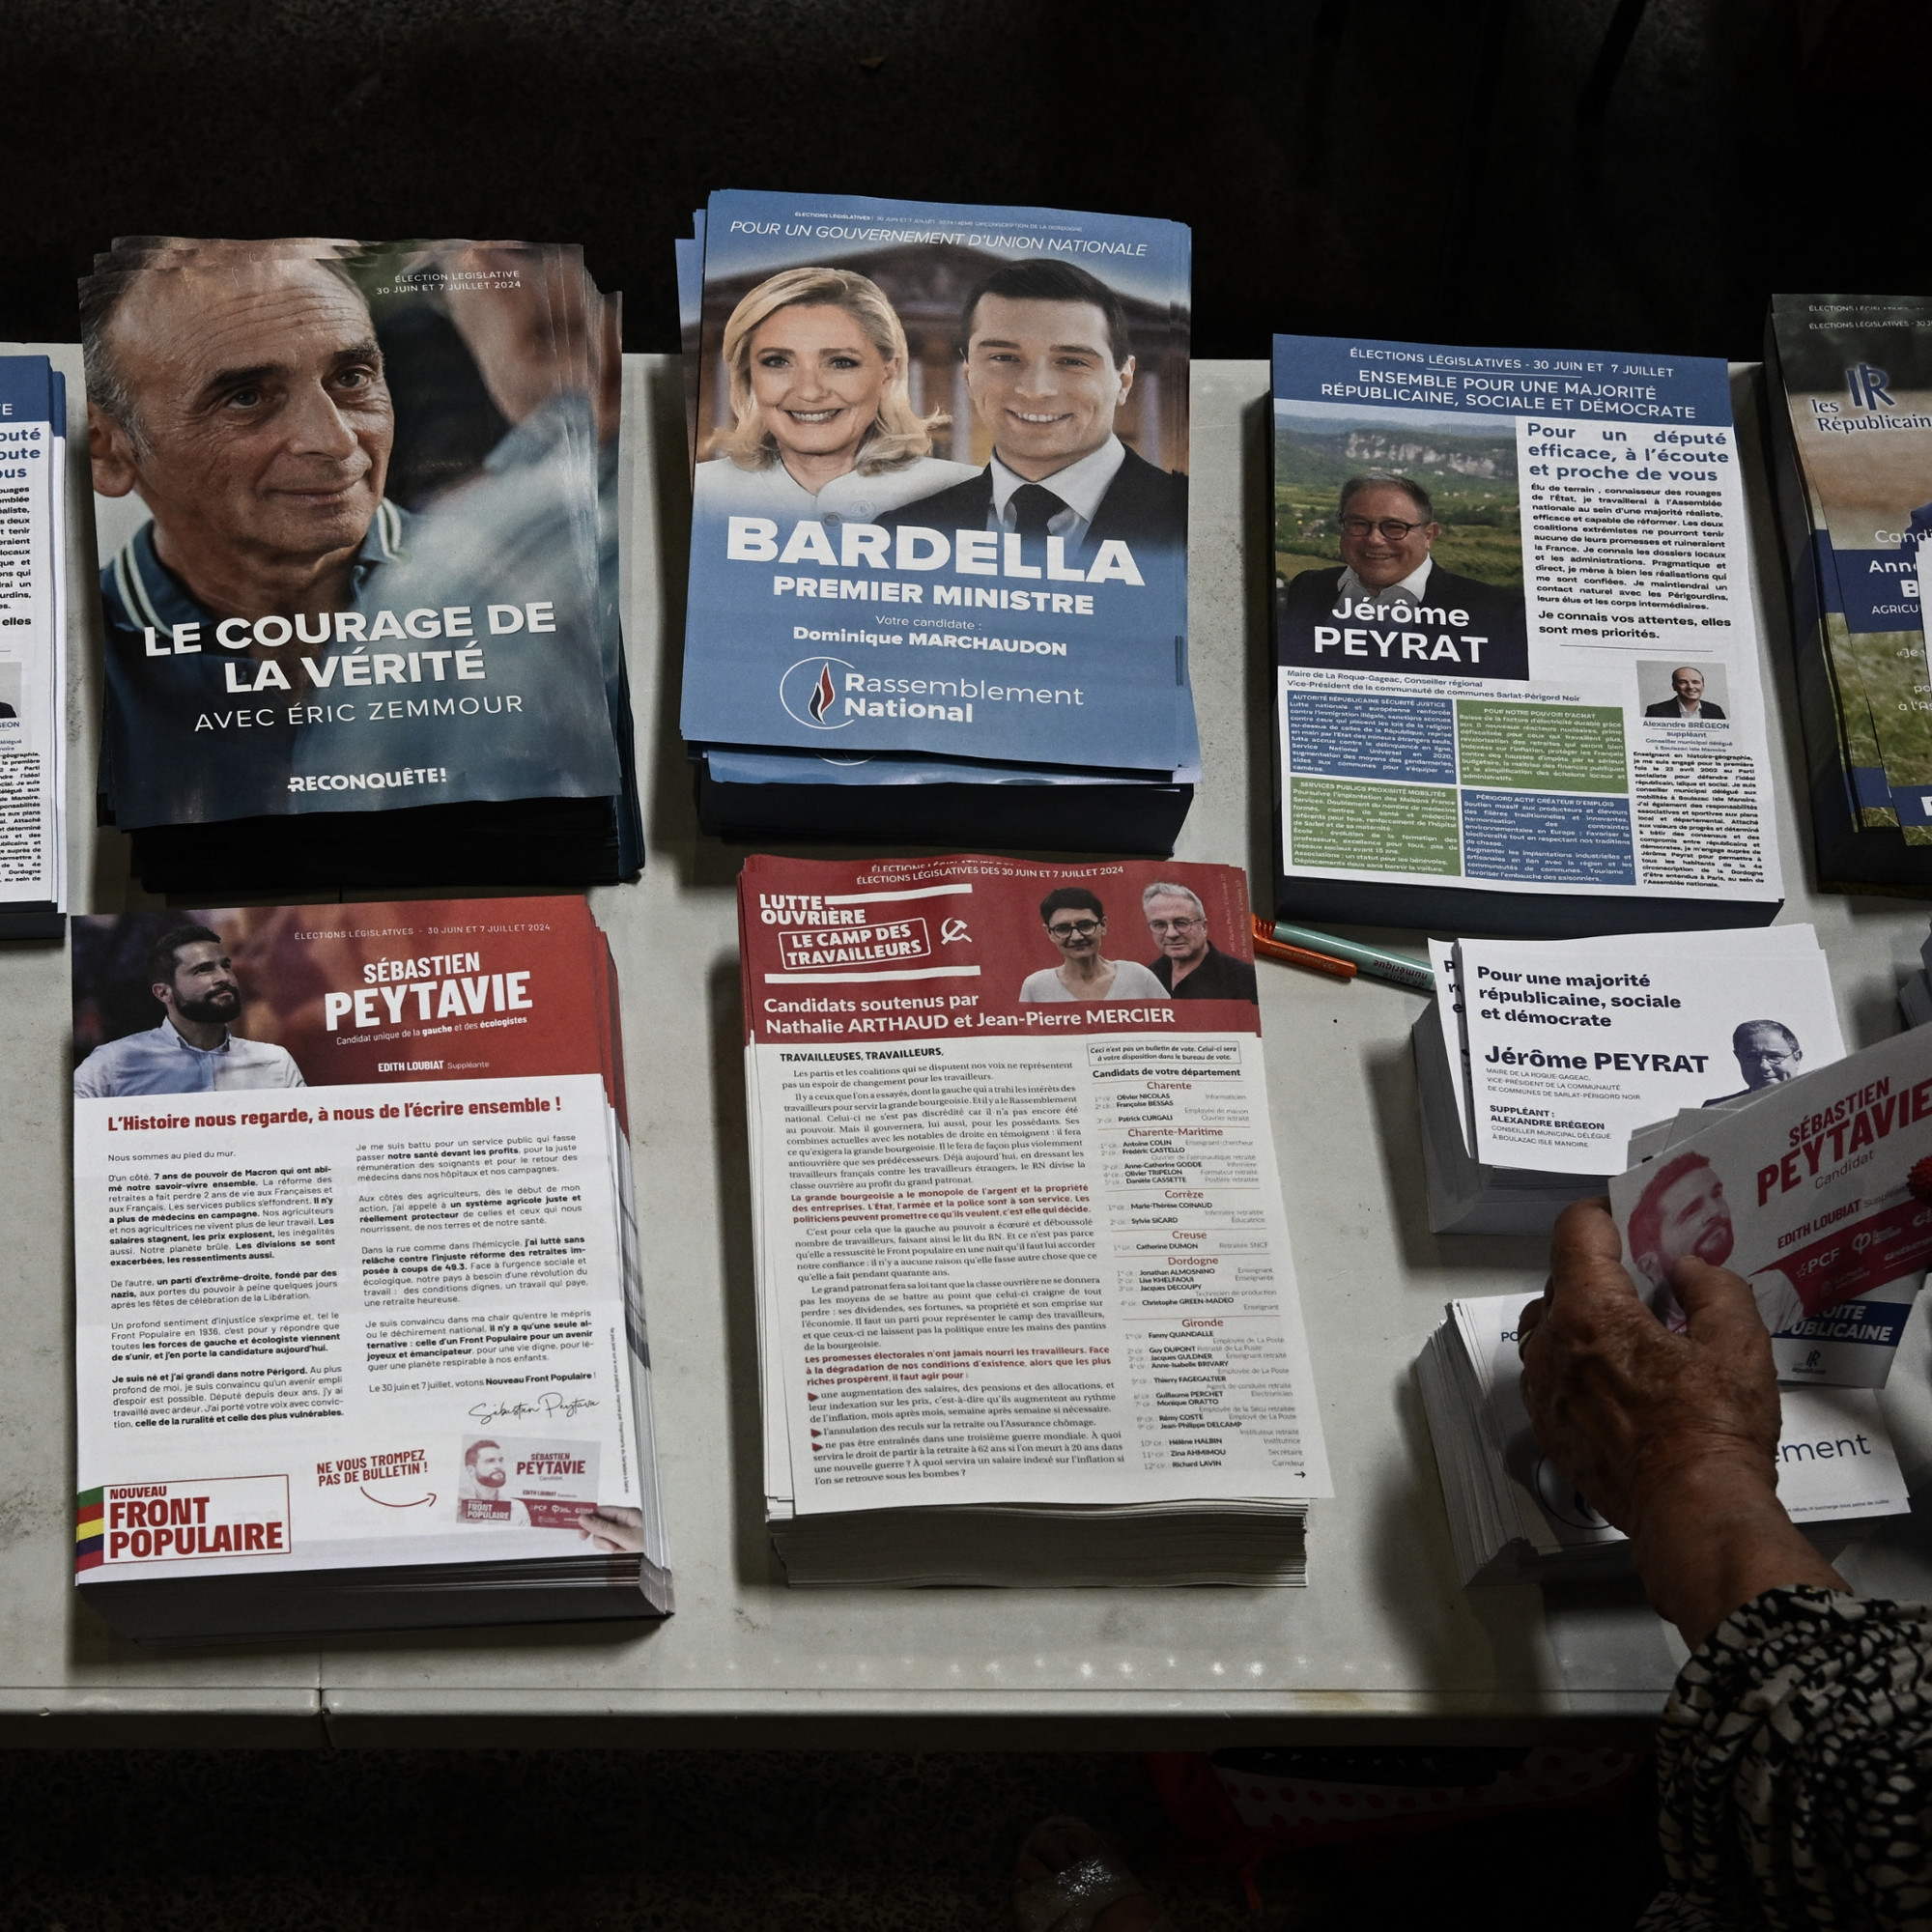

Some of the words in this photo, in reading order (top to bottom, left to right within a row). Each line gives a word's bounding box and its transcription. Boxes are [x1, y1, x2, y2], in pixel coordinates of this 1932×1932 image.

[729, 220, 781, 235] POUR
[784, 223, 811, 237] UN
[814, 225, 965, 244] GOUVERNEMENT
[1047, 238, 1148, 256] NATIONALE
[376, 286, 389, 295] 30
[393, 284, 418, 293] JUIN
[448, 281, 489, 291] JUILLET
[494, 280, 521, 289] 2024
[1350, 347, 1424, 362] ÉLECTIONS
[1428, 354, 1521, 369] LÉGISLATIVES
[1533, 359, 1548, 369] 30
[1552, 360, 1582, 371] JUIN
[1586, 361, 1604, 372] ET
[1610, 363, 1618, 373] 7
[1622, 364, 1673, 377] JUILLET
[1358, 369, 1457, 388] ENSEMBLE
[1463, 377, 1514, 391] POUR
[1520, 380, 1557, 393] UNE
[1564, 382, 1656, 400] MAJORITÉ
[1321, 383, 1459, 406] RÉPUBLICAINE,
[1465, 393, 1545, 410] SOCIALE
[1551, 397, 1574, 411] ET
[1579, 397, 1695, 418] DÉMOCRATE
[1810, 398, 1839, 413] les
[1527, 421, 1576, 439] Pour
[1602, 430, 1627, 441] un
[1653, 429, 1726, 446] député
[1816, 413, 1932, 434] Républicain
[1527, 442, 1616, 463] efficace,
[1625, 447, 1636, 461] à
[1528, 463, 1549, 475] et
[1556, 465, 1629, 480] proche
[1635, 467, 1662, 480] de
[1667, 470, 1718, 481] vous
[726, 515, 1146, 586] BARDELLA
[773, 575, 923, 603] PREMIER
[932, 584, 1094, 614] MINISTRE
[1, 615, 32, 627] elles
[874, 614, 909, 626] Votre
[912, 618, 975, 630] candidate
[1331, 594, 1469, 627] Jérôme
[1537, 610, 1553, 619] Je
[1556, 611, 1607, 622] connais
[1610, 614, 1634, 623] vos
[1637, 615, 1697, 627] attentes,
[1700, 617, 1731, 626] elles
[143, 621, 202, 657] LE
[215, 607, 474, 649] COURAGE
[487, 601, 555, 634] DE
[792, 625, 903, 646] Dominique
[908, 632, 1066, 656] MARCHAUDON
[1538, 625, 1568, 634] sont
[1571, 627, 1598, 636] mes
[1601, 627, 1660, 639] priorités.
[1314, 625, 1488, 663] PEYRAT
[224, 659, 291, 693] LA
[299, 639, 485, 687] VÉRITÉ
[844, 672, 1084, 705] Rassemblement
[194, 708, 274, 731] AVEC
[287, 701, 355, 724] ÉRIC
[367, 695, 523, 720] ZEMMOUR
[844, 696, 972, 723] National
[1642, 720, 1686, 730] Alexandre
[1688, 721, 1729, 729] BRÉGEON
[286, 766, 446, 792] RECONQUÊTE!
[856, 873, 911, 885] ÉLECTIONS
[912, 866, 979, 880] LÉGISLATIVES
[980, 866, 1000, 874] DES
[1001, 867, 1013, 875] 30
[1014, 867, 1037, 877] JUIN
[1061, 867, 1097, 878] JUILLET
[1099, 865, 1123, 875] 2024
[759, 894, 822, 910] LUTTE
[760, 907, 867, 925] OUVRIÈRE
[791, 935, 813, 948] LE
[816, 929, 872, 947] CAMP
[875, 923, 912, 941] DES
[786, 940, 923, 966] TRAVAILLEURS
[362, 951, 480, 983] SÉBASTIEN
[1477, 965, 1522, 982] Pour
[1525, 974, 1561, 985] une
[1565, 973, 1650, 990] majorité
[324, 970, 532, 1031] PEYTAVIE
[763, 997, 856, 1012] Candidats
[860, 996, 945, 1011] soutenus
[949, 994, 979, 1009] par
[1478, 986, 1605, 1009] républicaine,
[1610, 993, 1681, 1009] sociale
[765, 1018, 843, 1034] Nathalie
[847, 1013, 949, 1033] ARTHAUD
[952, 1013, 973, 1028] et
[976, 1010, 1081, 1027] Jean-Pierre
[1086, 1008, 1175, 1024] MERCIER
[1480, 1007, 1501, 1020] et
[1504, 1009, 1611, 1027] démocrate
[335, 1034, 371, 1045] Candidat
[372, 1031, 399, 1040] unique
[401, 1029, 412, 1037] de
[421, 1024, 452, 1037] gauche
[478, 1016, 527, 1028] écologistes
[377, 1062, 405, 1072] EDITH
[406, 1060, 444, 1070] LOUBIAT
[779, 1051, 864, 1062] TRAVAILLEUSES,
[864, 1046, 943, 1060] TRAVAILLEURS,
[1484, 1044, 1587, 1071] Jérôme
[1593, 1051, 1709, 1073] PEYRAT
[1092, 1067, 1140, 1078] Candidats
[1140, 1066, 1153, 1075] de
[1180, 1067, 1240, 1077] département
[1146, 1080, 1192, 1090] Charente
[194, 1114, 237, 1127] nous
[241, 1107, 313, 1128] regarde,
[318, 1106, 328, 1122] à
[332, 1107, 375, 1121] nous
[379, 1103, 400, 1119] de
[468, 1096, 551, 1115] ensemble
[1788, 1075, 1890, 1148] SÉBASTIEN
[1126, 1126, 1223, 1137] Charente-Maritime
[1756, 1077, 1932, 1208] PEYTAVIE
[1814, 1150, 1875, 1190] Candidat
[1163, 1189, 1204, 1199] Corrèze
[1171, 1230, 1207, 1239] Creuse
[1777, 1223, 1811, 1249] EDITH
[1812, 1198, 1862, 1232] LOUBIAT
[1167, 1256, 1218, 1266] Dordogne
[1807, 1246, 1841, 1274] PCF
[1180, 1318, 1223, 1327] Gironde
[317, 1462, 332, 1474] NE
[336, 1457, 367, 1472] VOUS
[371, 1449, 425, 1466] TROMPEZ
[516, 1460, 585, 1475] PEYTAVIE
[319, 1473, 341, 1487] PAS
[344, 1470, 359, 1484] DE
[363, 1463, 420, 1481] BULLETIN
[109, 1485, 166, 1499] NOUVEAU
[109, 1494, 210, 1529] FRONT
[109, 1521, 283, 1558] POPULAIRE
